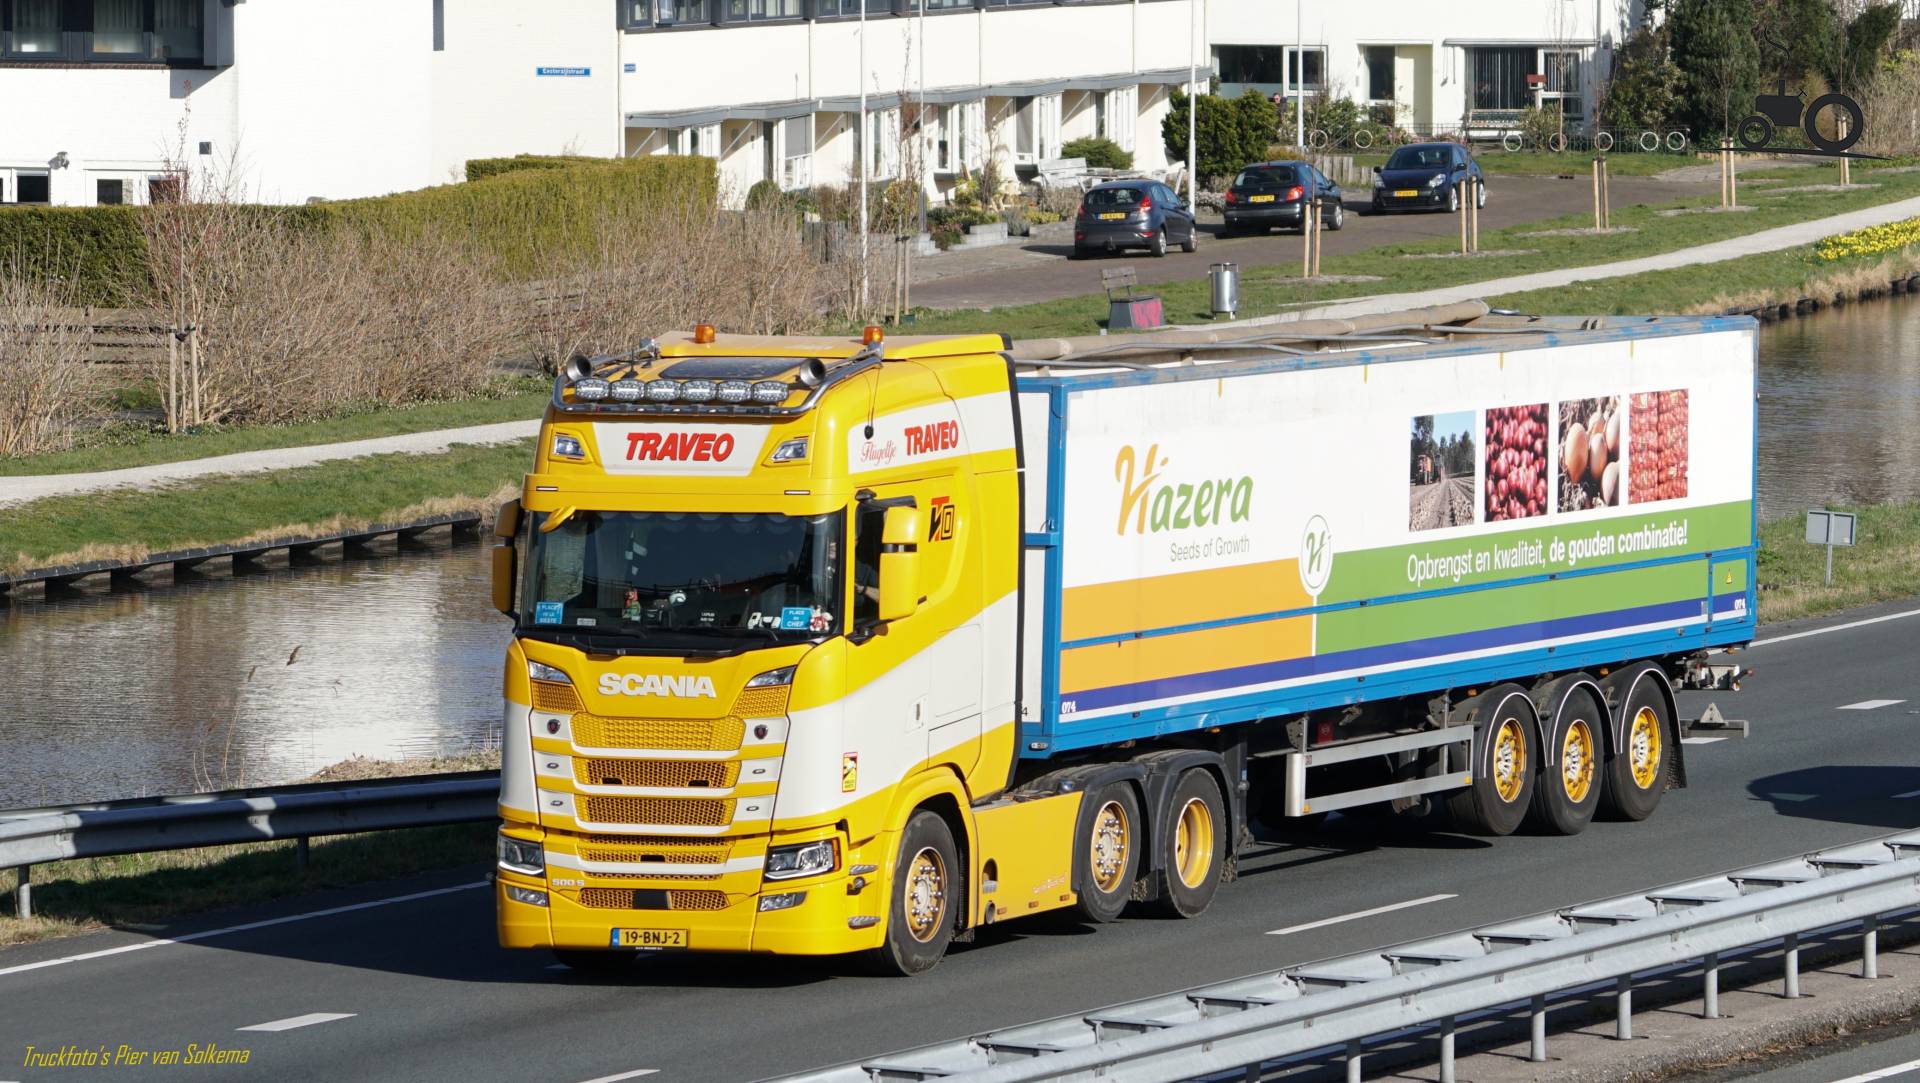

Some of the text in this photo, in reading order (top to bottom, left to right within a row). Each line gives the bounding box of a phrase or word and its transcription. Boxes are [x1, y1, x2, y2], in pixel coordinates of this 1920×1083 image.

[626, 432, 735, 462] TRAVEO
[904, 419, 959, 456] TRAVEO
[1114, 443, 1254, 537] Hazera
[1170, 534, 1250, 562] Seeds of Growth
[1407, 519, 1688, 588] Opbrengst en kwaliteit, de gouden combinatie!
[597, 672, 717, 698] SCANIA
[1061, 700, 1076, 714] 074
[625, 931, 680, 944] 19-BNJ-2
